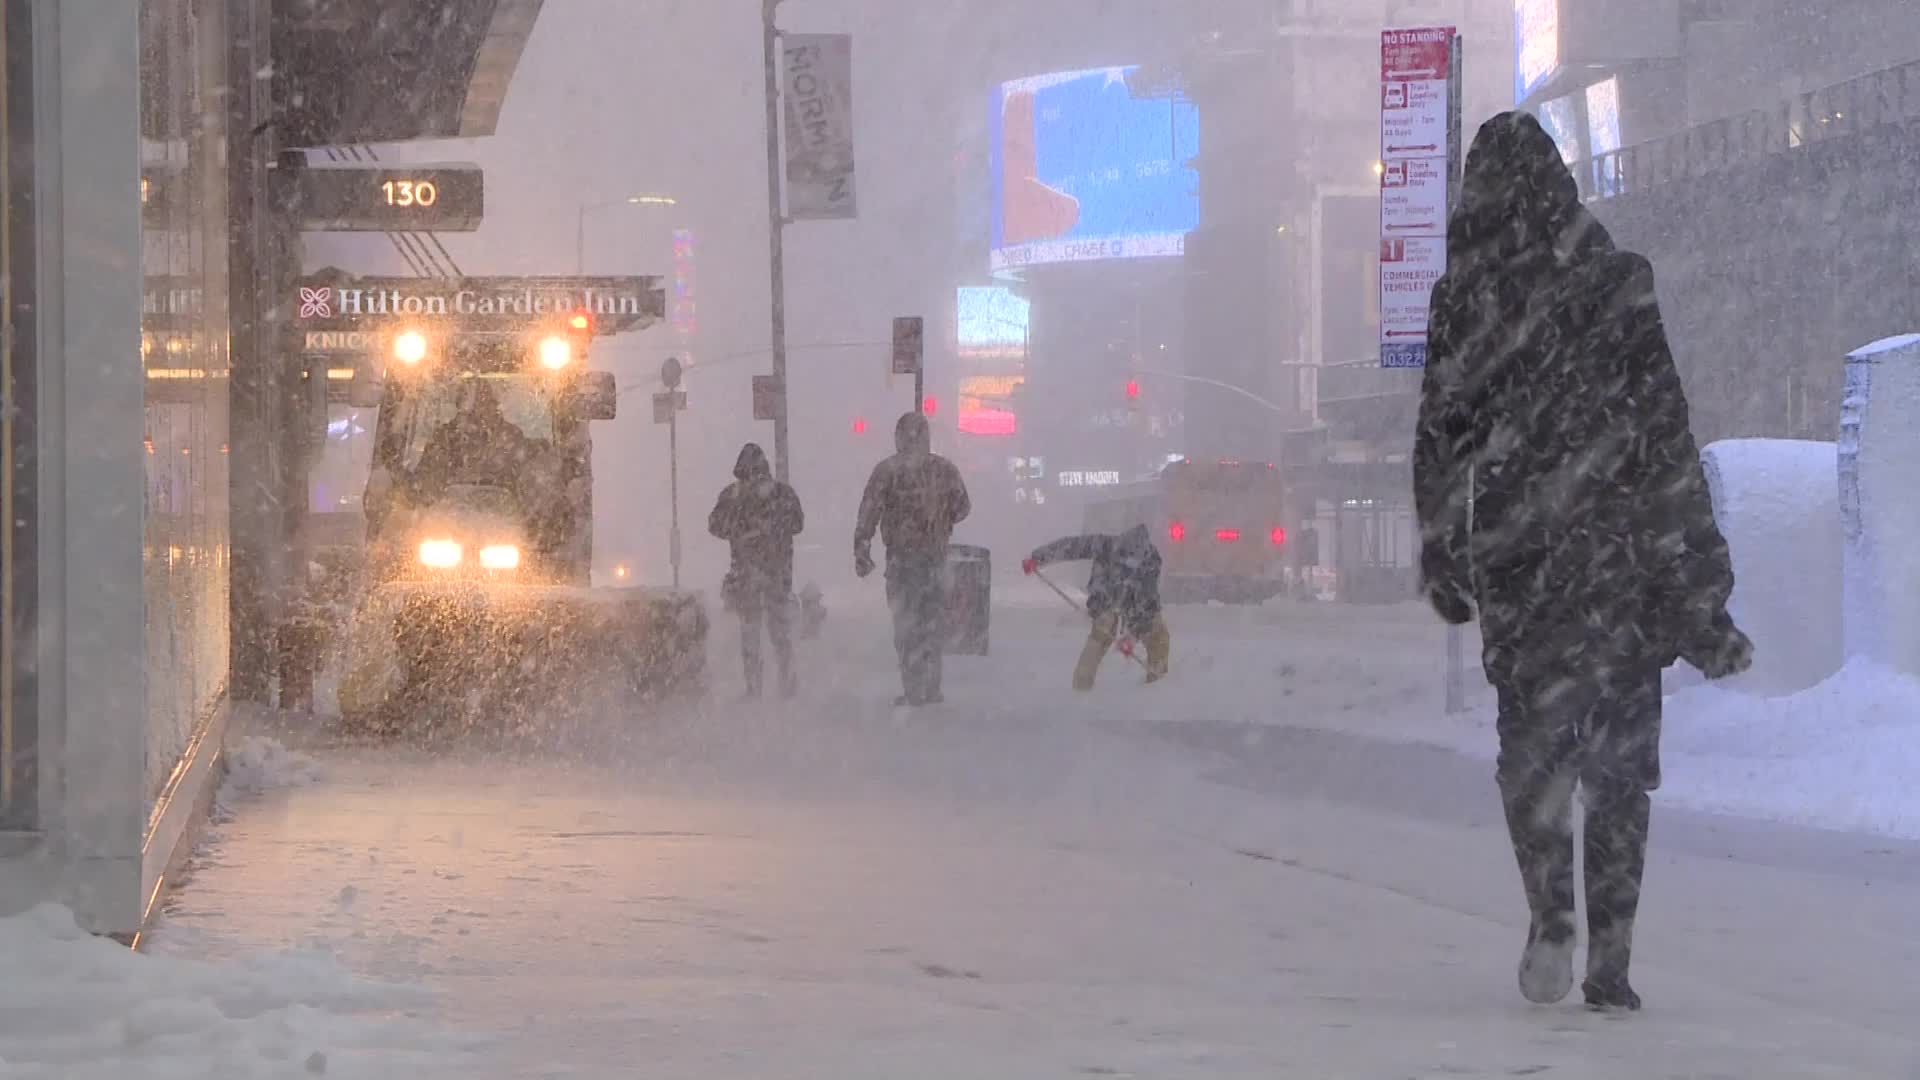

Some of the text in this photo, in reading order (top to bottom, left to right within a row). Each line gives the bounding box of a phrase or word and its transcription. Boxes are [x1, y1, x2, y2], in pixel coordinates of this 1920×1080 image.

[1383, 31, 1445, 44] NO STANDING
[1409, 90, 1438, 100] Loading
[382, 180, 437, 206] 130
[1383, 270, 1439, 280] COMMERCIAL
[1383, 280, 1425, 292] VEHICLES
[338, 286, 640, 315] Hilton Garden Inn
